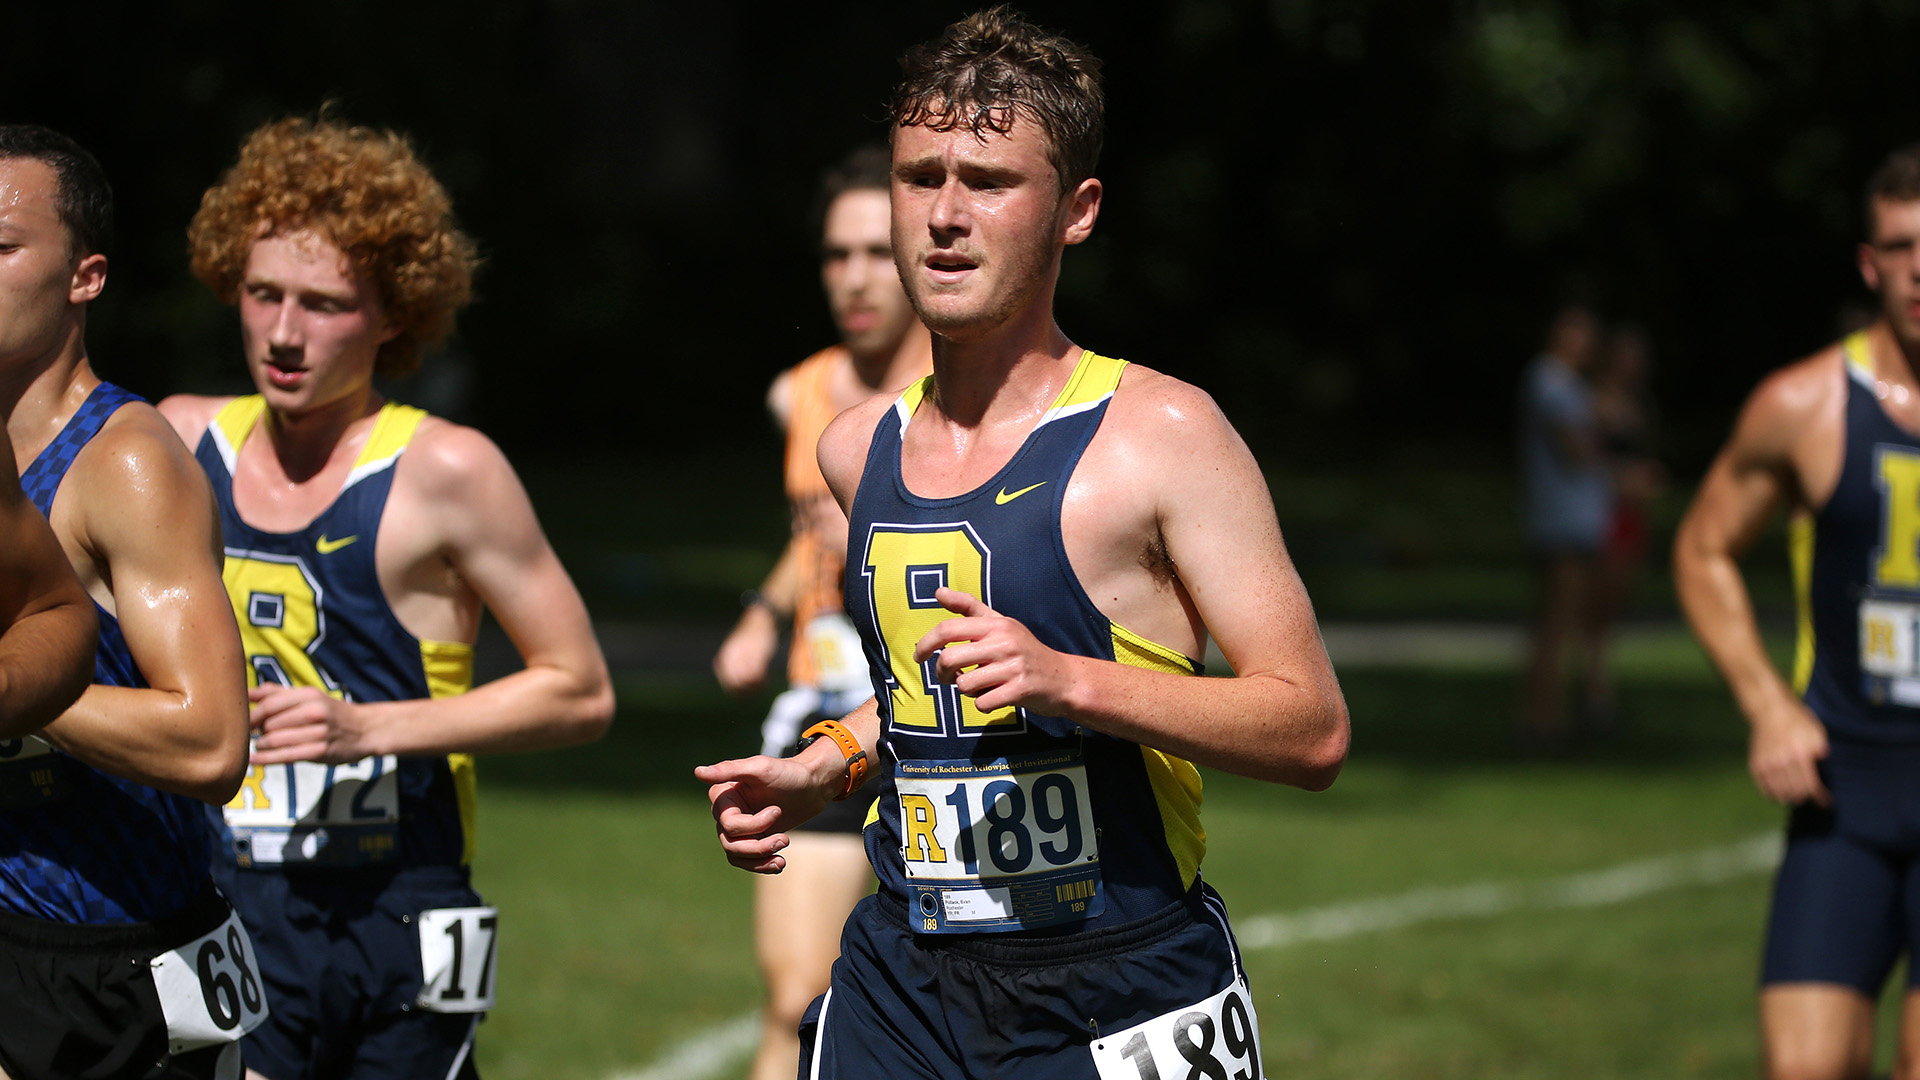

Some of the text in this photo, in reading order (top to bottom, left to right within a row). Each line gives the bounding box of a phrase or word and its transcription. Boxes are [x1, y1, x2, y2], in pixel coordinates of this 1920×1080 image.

[903, 764, 930, 775] University
[931, 765, 939, 773] of
[939, 764, 973, 773] Rochester
[1024, 755, 1071, 768] Invitational
[901, 773, 1083, 875] R 189
[923, 918, 938, 931] 189
[1071, 901, 1085, 912] 189
[197, 924, 262, 1031] 68
[1120, 991, 1260, 1080] 189
